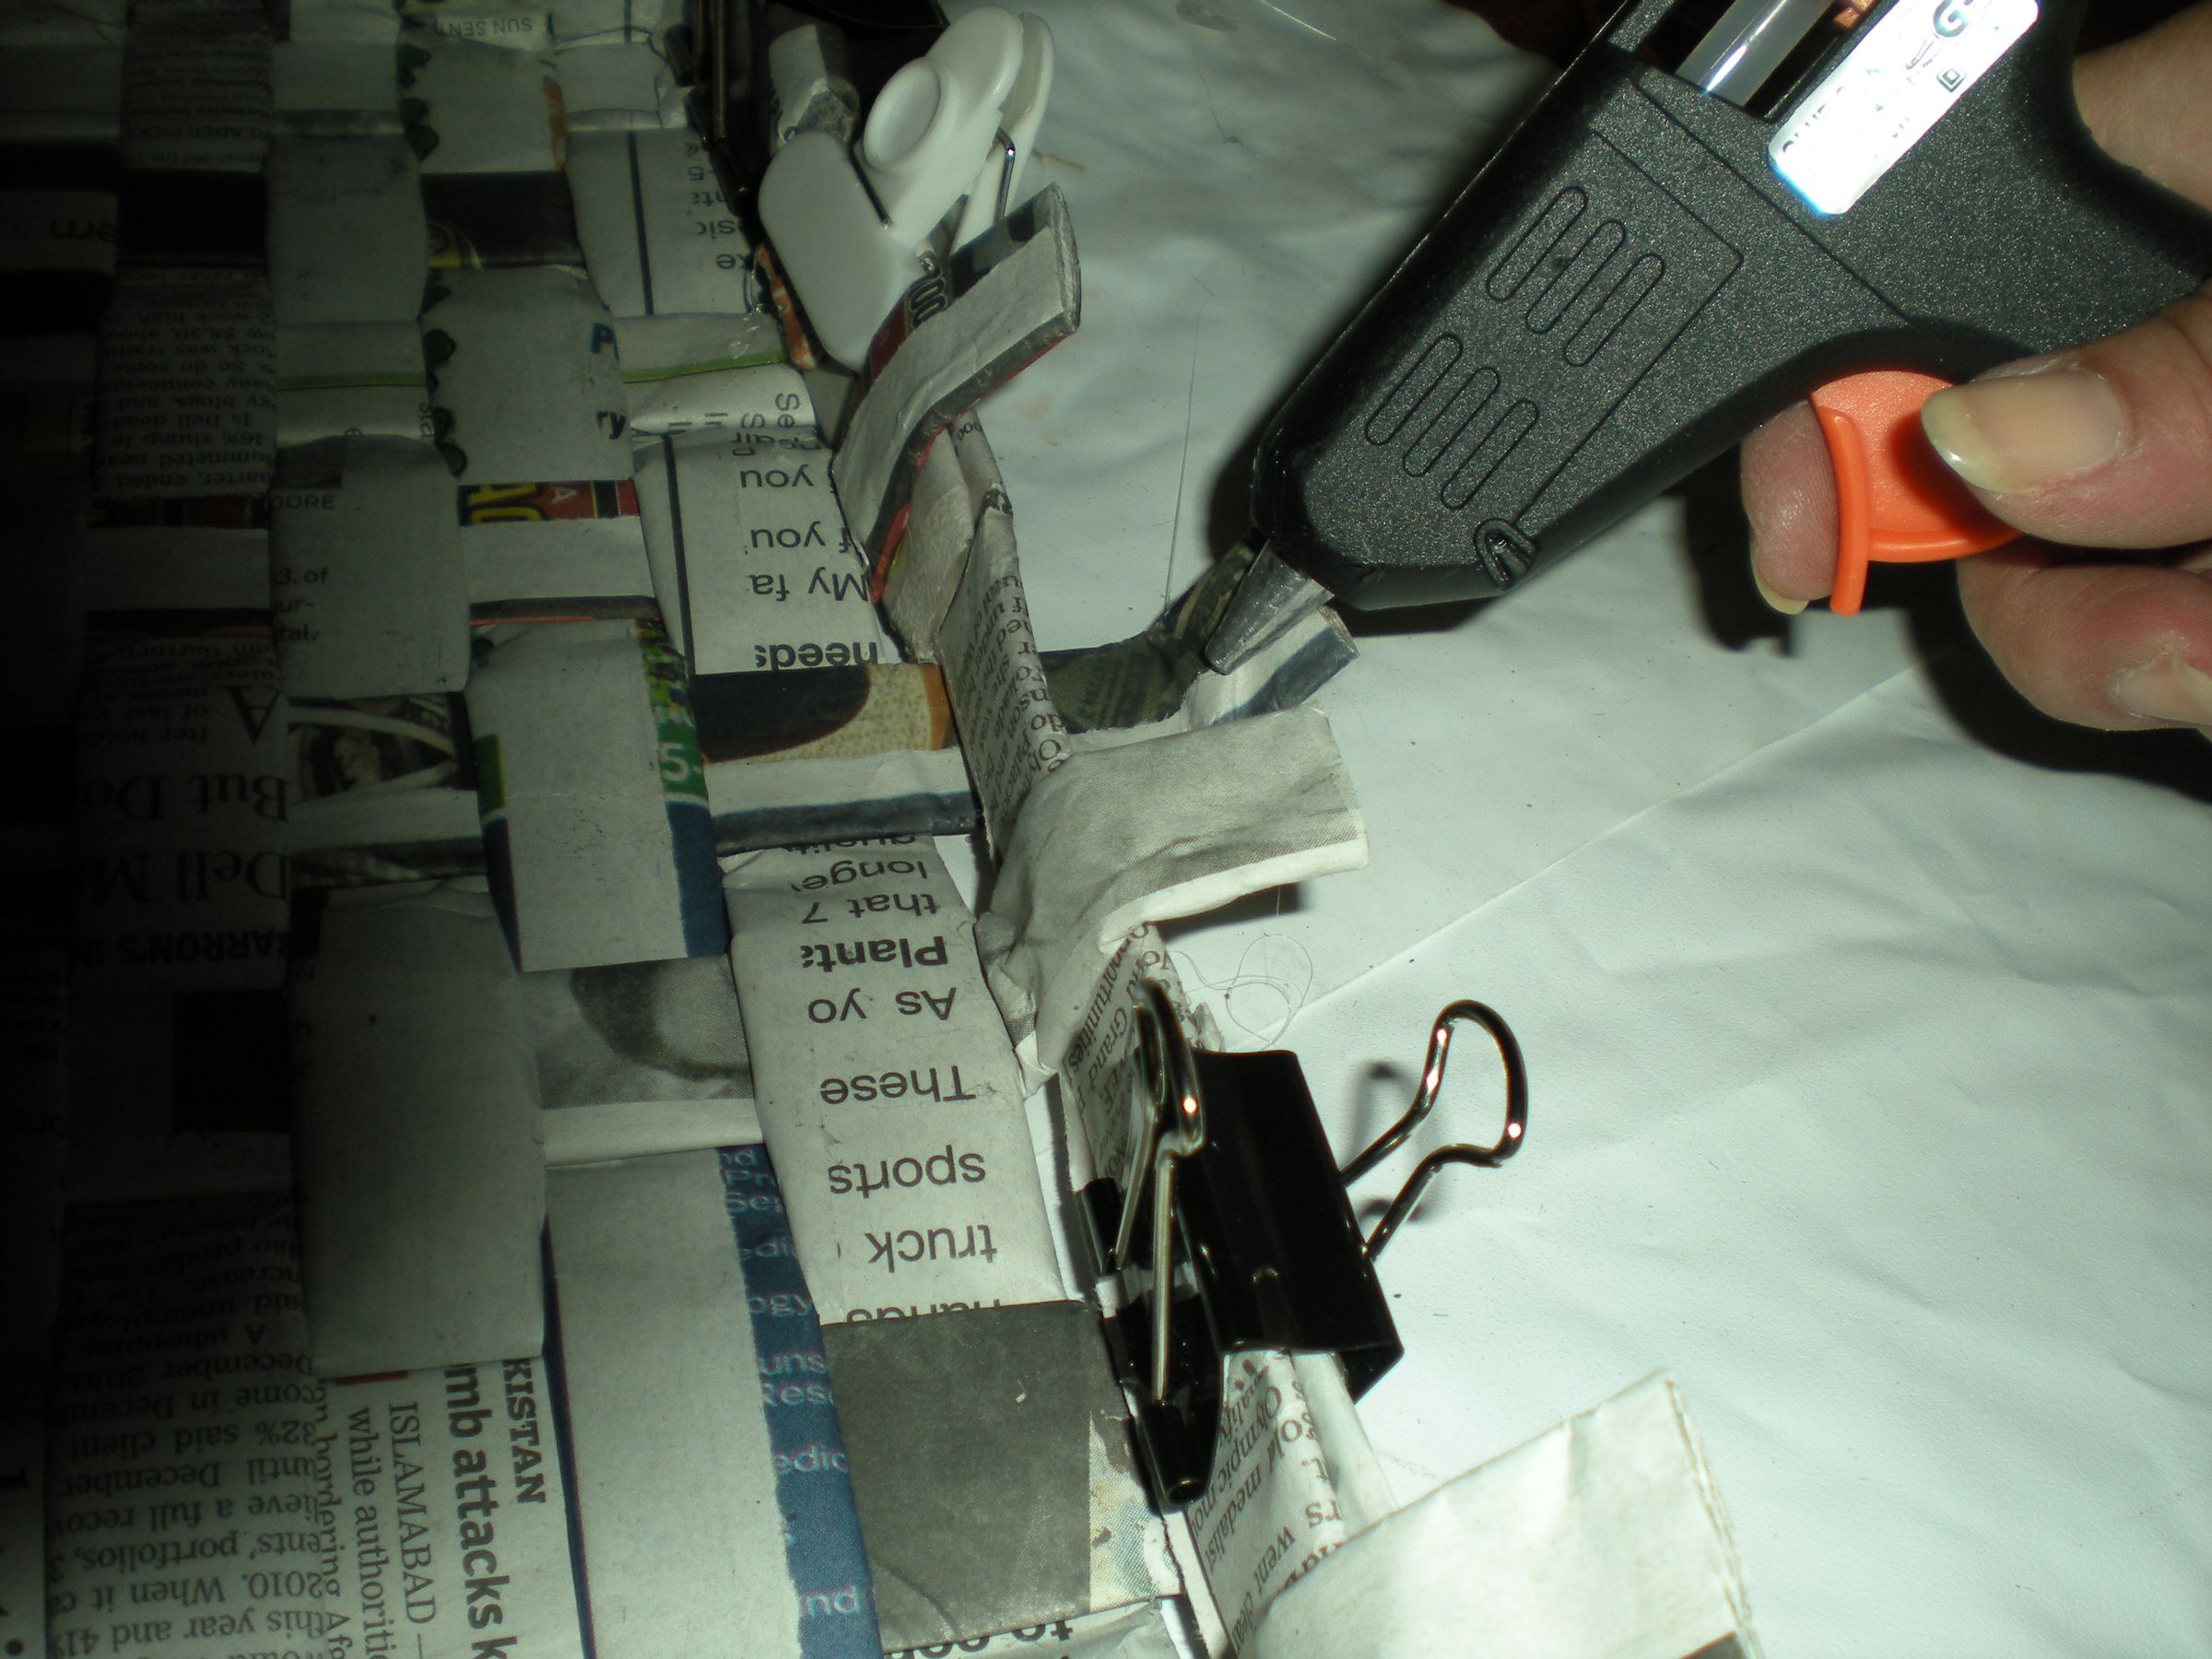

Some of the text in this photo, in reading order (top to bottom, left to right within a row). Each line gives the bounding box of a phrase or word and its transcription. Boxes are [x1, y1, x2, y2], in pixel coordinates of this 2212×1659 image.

[740, 465, 815, 489] you
[304, 567, 328, 585] of
[807, 567, 869, 602] My
[181, 773, 289, 824] But
[176, 850, 289, 904] Dell
[848, 891, 937, 916] that
[807, 986, 957, 1026] As yo
[819, 1065, 977, 1105] These
[827, 1144, 987, 1199] sports
[864, 1223, 999, 1275] truck
[188, 1389, 221, 1417] in
[172, 1423, 240, 1454] said
[254, 1419, 318, 1447] 32%
[501, 1358, 547, 1504] KISTAN
[347, 1407, 383, 1497] while
[58, 1456, 319, 1500] until December
[148, 1500, 203, 1532] full
[214, 1497, 235, 1521] a
[388, 1400, 437, 1624] ISLAMABAD
[73, 1529, 239, 1574] portfolios,
[450, 1449, 511, 1630] attacks
[89, 1584, 115, 1614] it
[129, 1575, 227, 1607] When
[241, 1571, 324, 1600] 2010.
[112, 1620, 172, 1653] and
[183, 1607, 255, 1640] year
